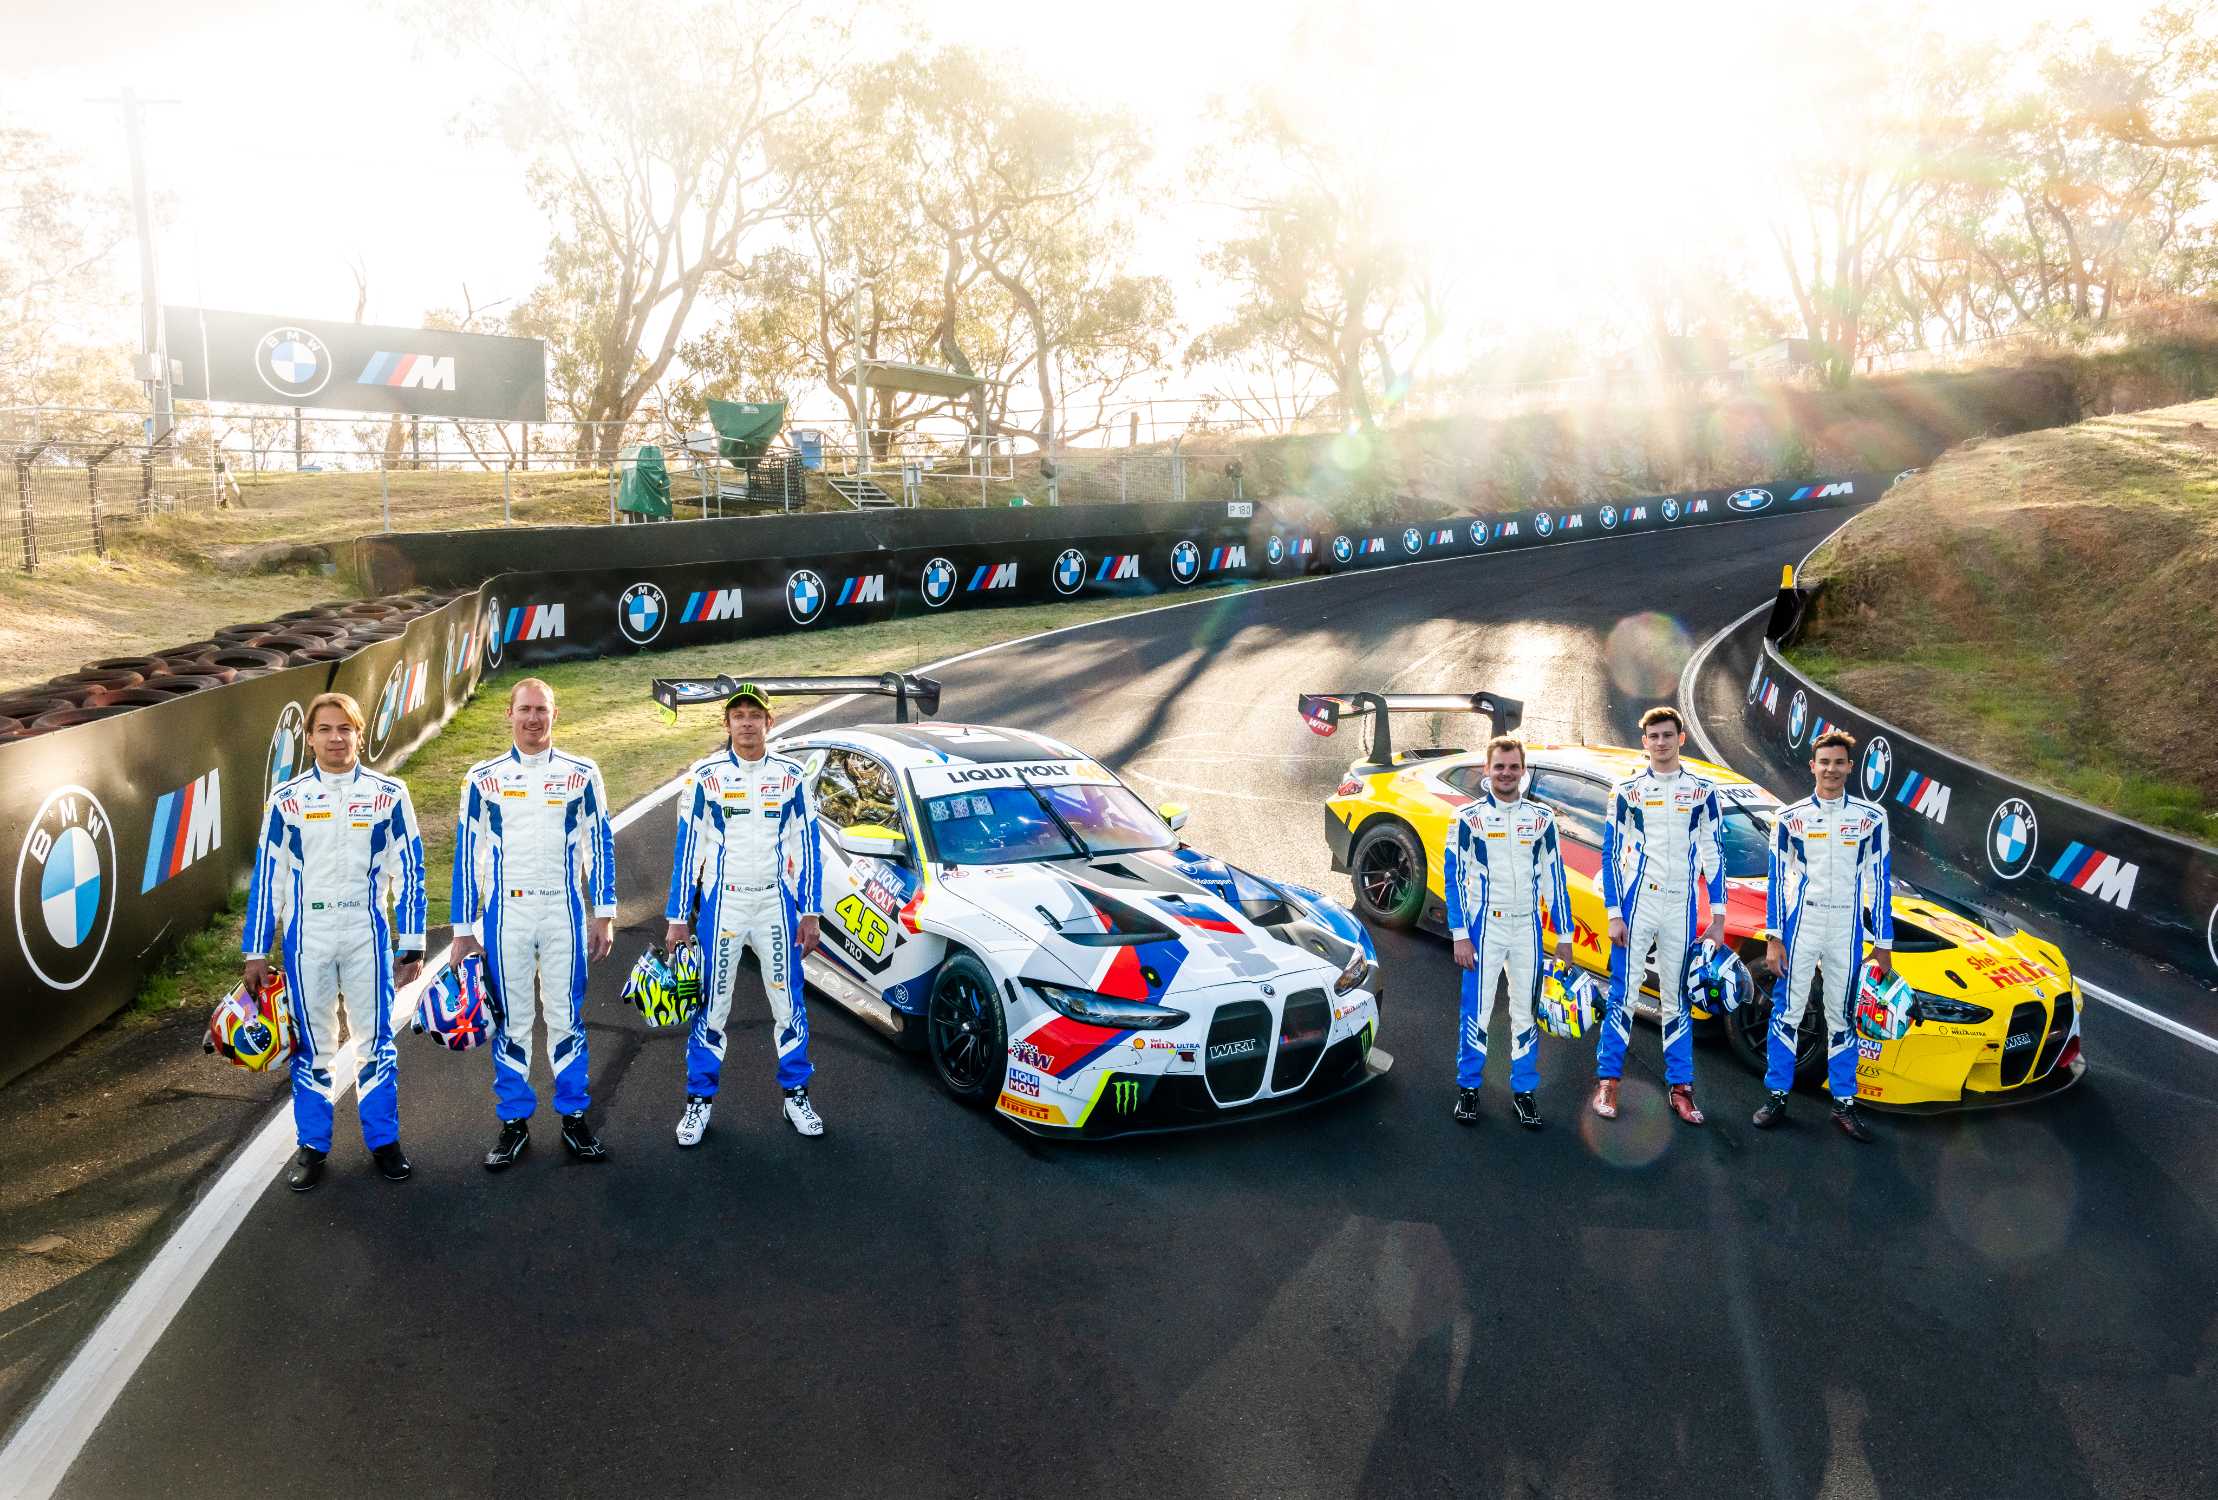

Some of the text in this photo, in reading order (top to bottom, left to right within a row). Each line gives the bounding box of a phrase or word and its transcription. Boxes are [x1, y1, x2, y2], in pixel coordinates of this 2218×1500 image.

[265, 331, 321, 352] BMW
[790, 572, 820, 589] BMW
[624, 586, 662, 604] BMW
[274, 708, 303, 751] BMW
[947, 765, 1070, 784] LIQUI MOLY
[1724, 787, 1760, 799] MOLY
[1999, 802, 2034, 830] BMW
[30, 795, 107, 865] BMW
[876, 866, 902, 897] LIQUI
[867, 880, 896, 913] MOLY
[834, 893, 889, 956] 46
[770, 924, 786, 992] mooney
[844, 938, 863, 961] PRO
[716, 928, 736, 995] mooney
[1210, 1038, 1256, 1060] WRT
[1857, 1039, 1882, 1052] IQUI
[1858, 1048, 1880, 1060] OLY
[1017, 1049, 1055, 1071] KW
[1857, 1064, 1880, 1076] LESS
[1010, 1068, 1039, 1083] LIQUI
[1010, 1080, 1040, 1097] MOLY
[1001, 1095, 1049, 1120] PIRELLI
